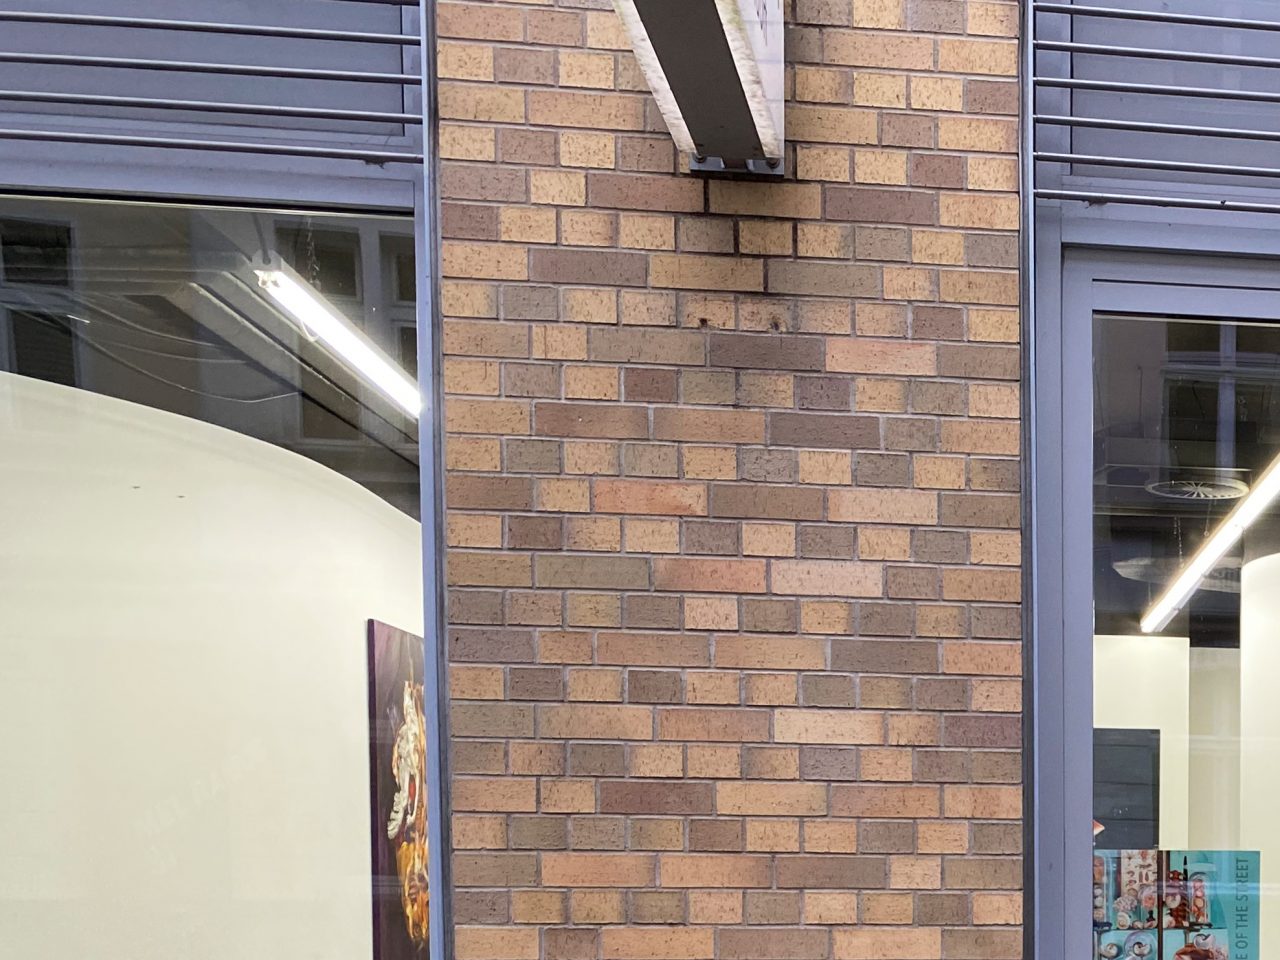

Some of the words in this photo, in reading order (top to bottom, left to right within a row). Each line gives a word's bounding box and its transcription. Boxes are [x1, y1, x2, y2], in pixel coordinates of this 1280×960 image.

[1235, 858, 1249, 902] STREET
[1235, 906, 1249, 929] THE
[1235, 933, 1249, 949] OF
